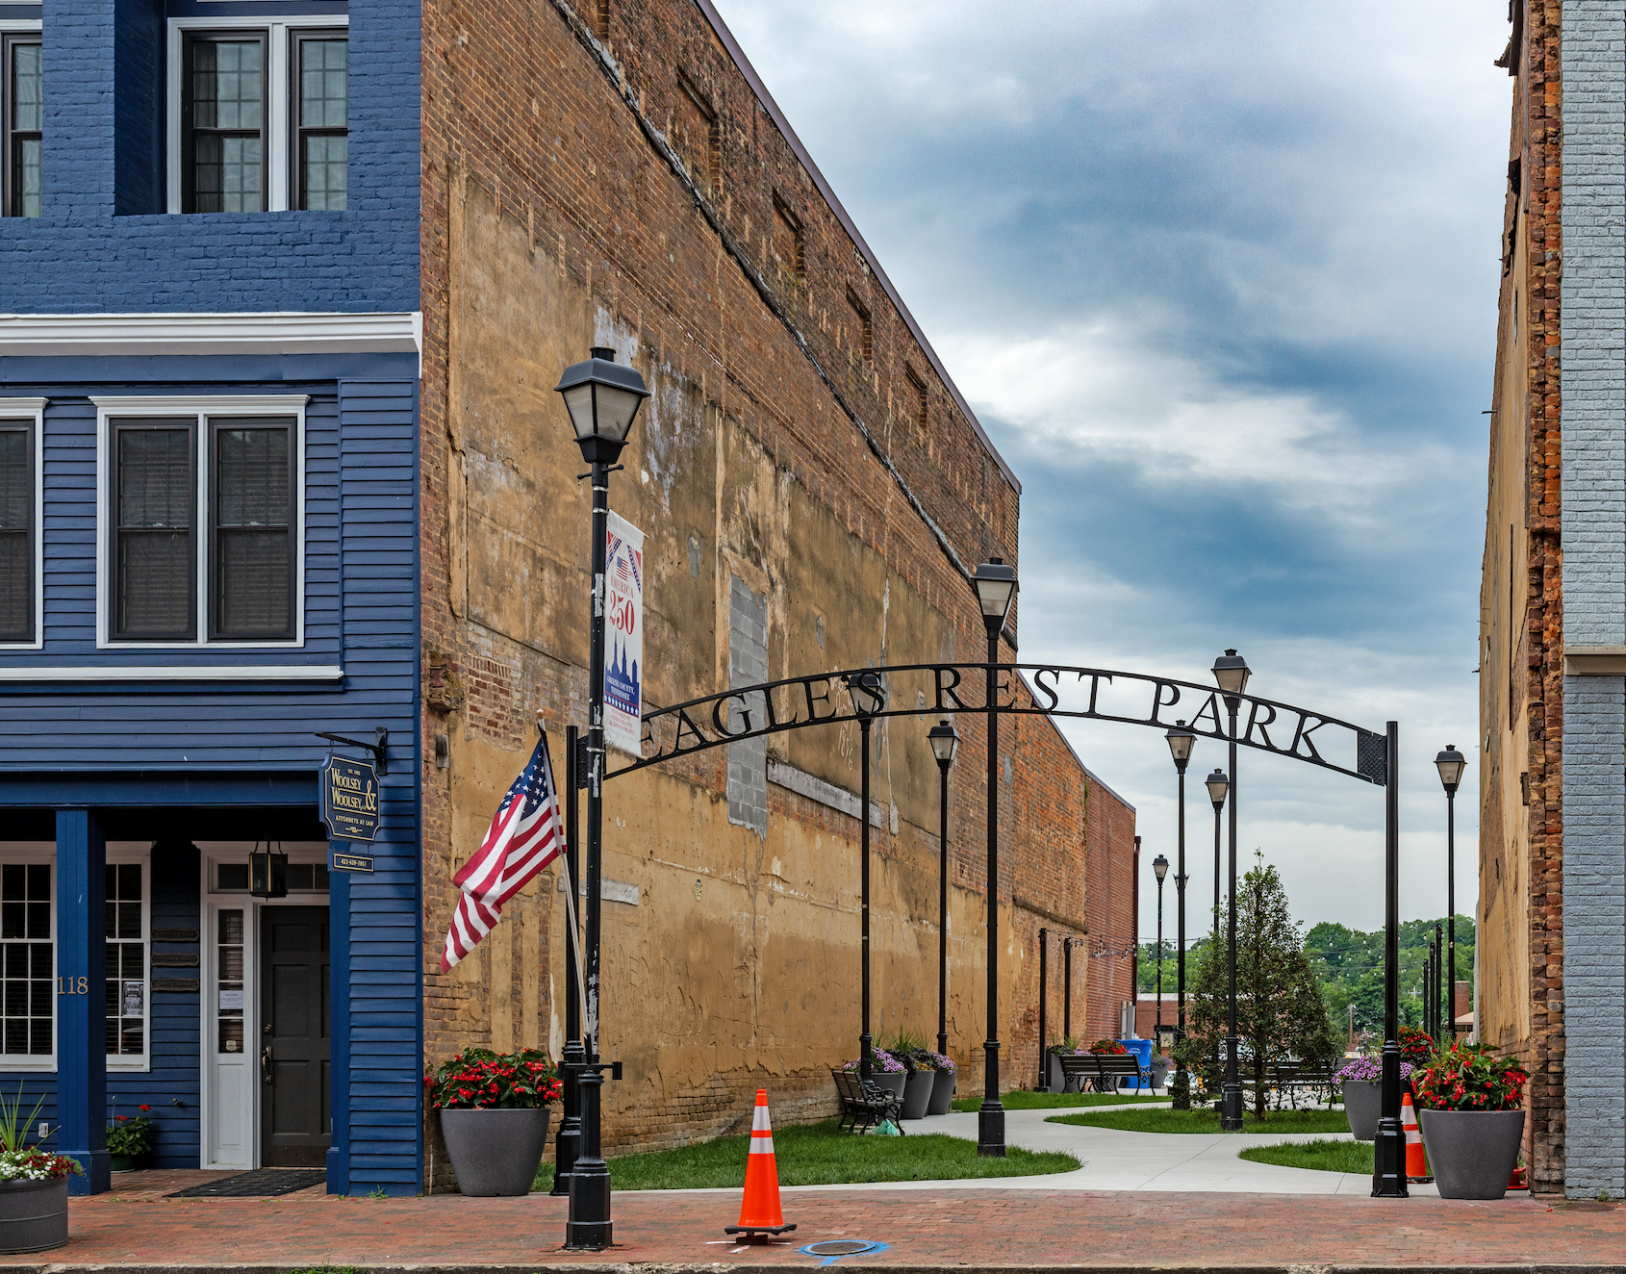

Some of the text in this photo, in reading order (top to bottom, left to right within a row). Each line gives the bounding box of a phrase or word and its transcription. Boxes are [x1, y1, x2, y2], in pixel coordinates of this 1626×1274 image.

[610, 575, 634, 599] AMERICA
[609, 589, 635, 635] 250
[930, 666, 1113, 715] REST
[1146, 679, 1335, 765] PARK
[365, 779, 377, 812] &
[335, 815, 359, 825] ATTORNEYS
[57, 976, 89, 995] 118
